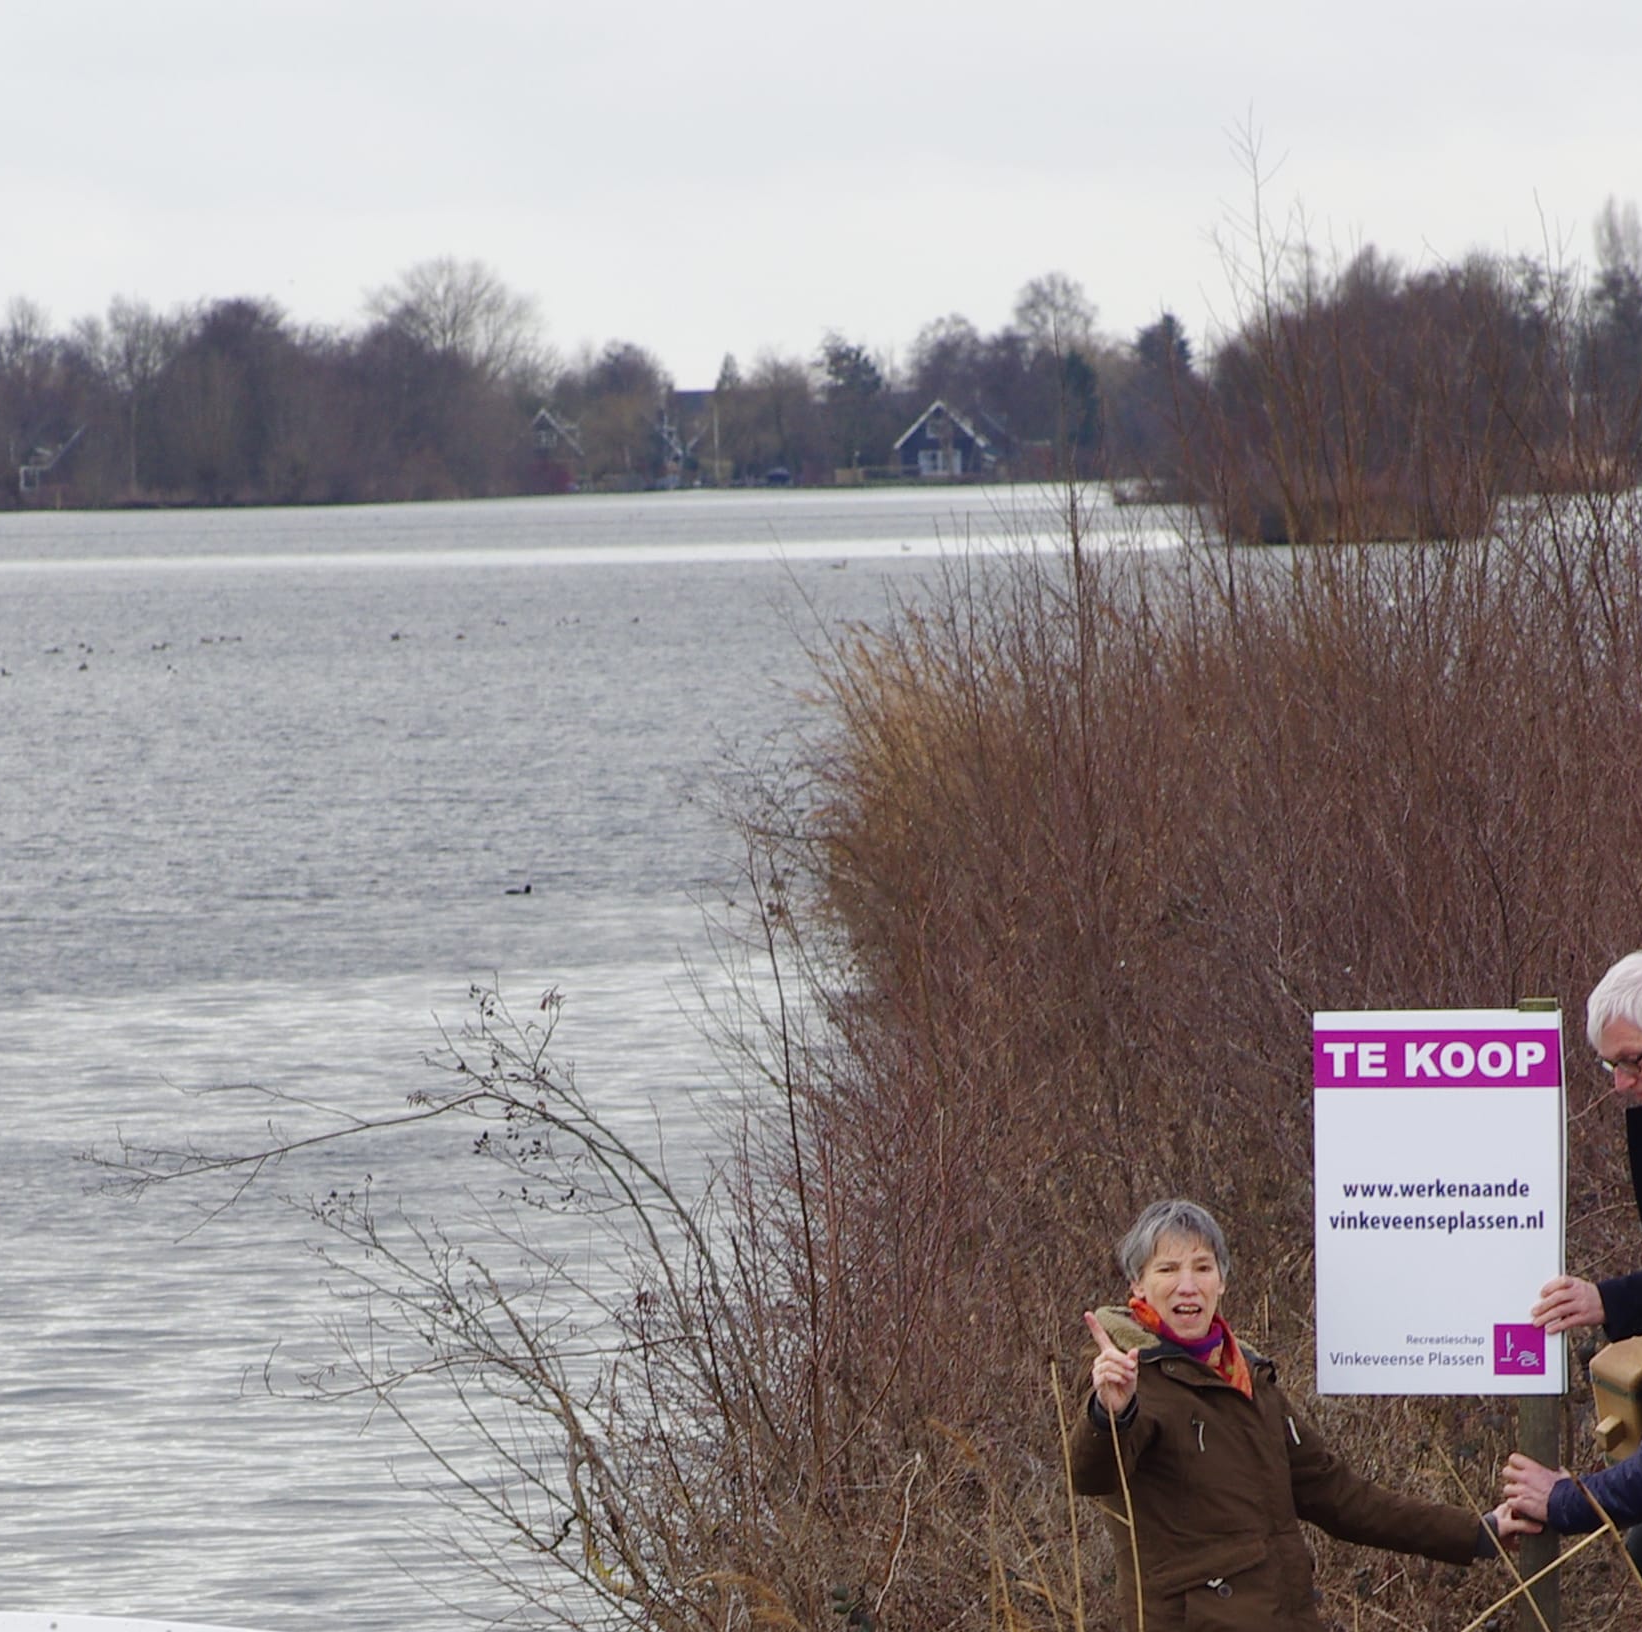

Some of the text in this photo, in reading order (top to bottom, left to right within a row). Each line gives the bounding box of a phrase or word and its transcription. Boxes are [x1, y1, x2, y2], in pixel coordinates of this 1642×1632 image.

[1323, 1041, 1546, 1078] TE KOOP
[1343, 1178, 1530, 1198] www.werkenaande
[1329, 1210, 1545, 1234] vinkeveenseplassen.nl
[1406, 1334, 1485, 1348] Recreatieschap
[1330, 1351, 1485, 1367] Vinkeveense Plassen
